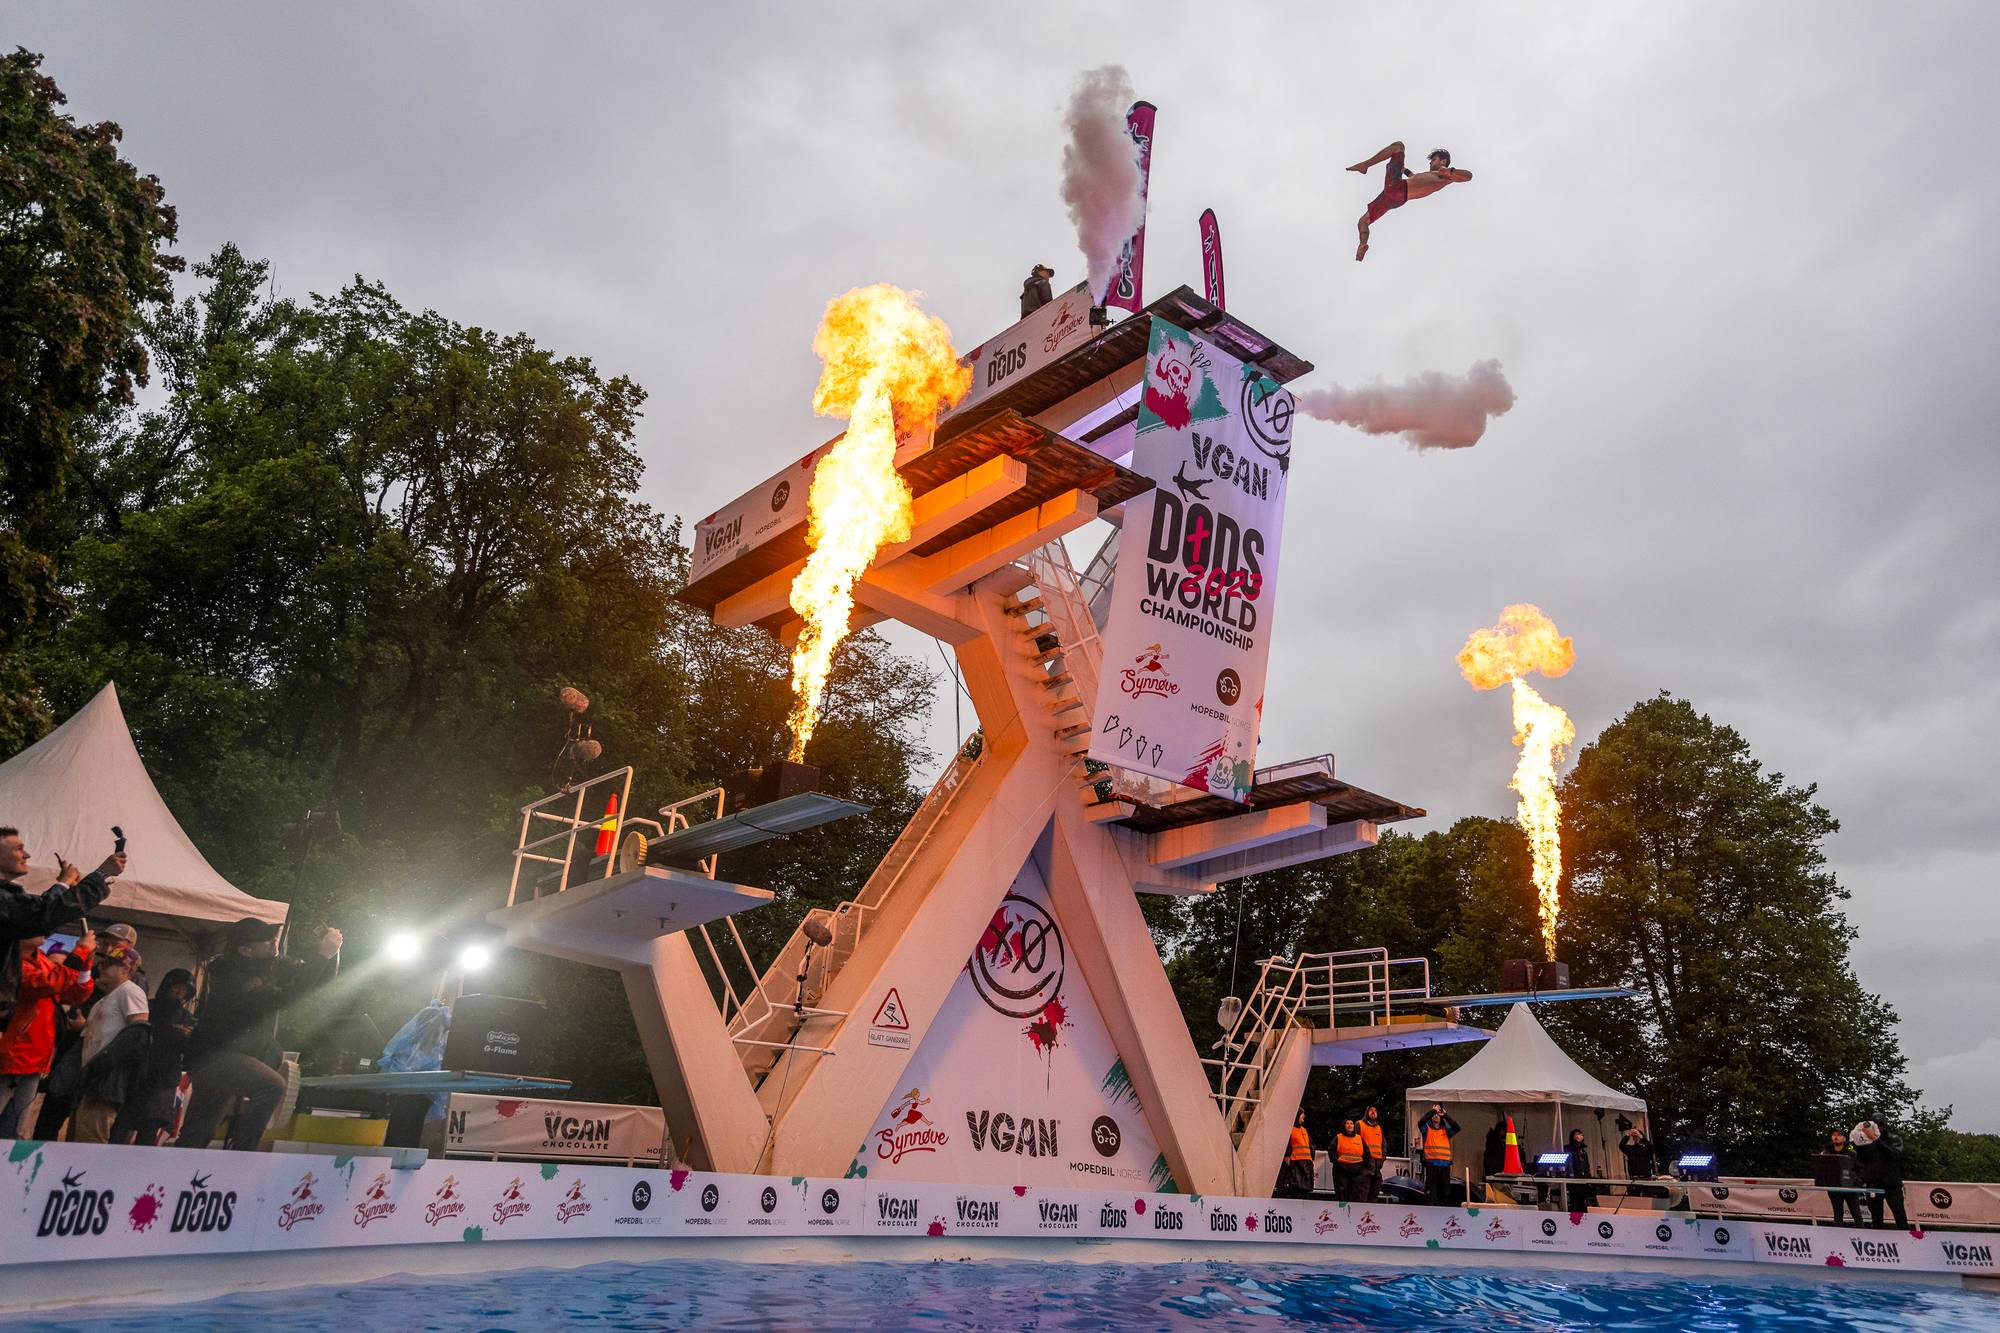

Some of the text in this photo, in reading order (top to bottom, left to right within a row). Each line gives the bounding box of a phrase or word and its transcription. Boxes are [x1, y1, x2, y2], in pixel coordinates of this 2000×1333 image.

[1191, 432, 1269, 501] VGAN
[705, 515, 743, 555] VGAN
[1181, 564, 1263, 601] 2023
[1146, 562, 1257, 633] WORLD
[1140, 598, 1254, 651] CHAMPIONSHIP
[1120, 669, 1180, 700] Synnøve
[1190, 703, 1230, 723] MOPEDBIL
[544, 1116, 611, 1141] VGAN
[966, 1110, 1059, 1158] VGAN
[542, 1140, 609, 1150] CHOCOLATE
[874, 1128, 949, 1165] Synnøve
[1069, 1162, 1115, 1177] MOPEDBIL
[878, 1198, 918, 1219] VGAN
[956, 1199, 999, 1221] VGAN
[1038, 1201, 1078, 1223] VGAN
[615, 1217, 643, 1225] MOPEDBIL
[685, 1217, 712, 1225] MOPEDBIL
[747, 1218, 772, 1226] MOPEDBIL
[807, 1218, 834, 1226] MOPEDBIL
[1764, 1235, 1811, 1253] VGAN
[1851, 1240, 1899, 1258] VGAN
[1942, 1244, 1992, 1261] VGAN
